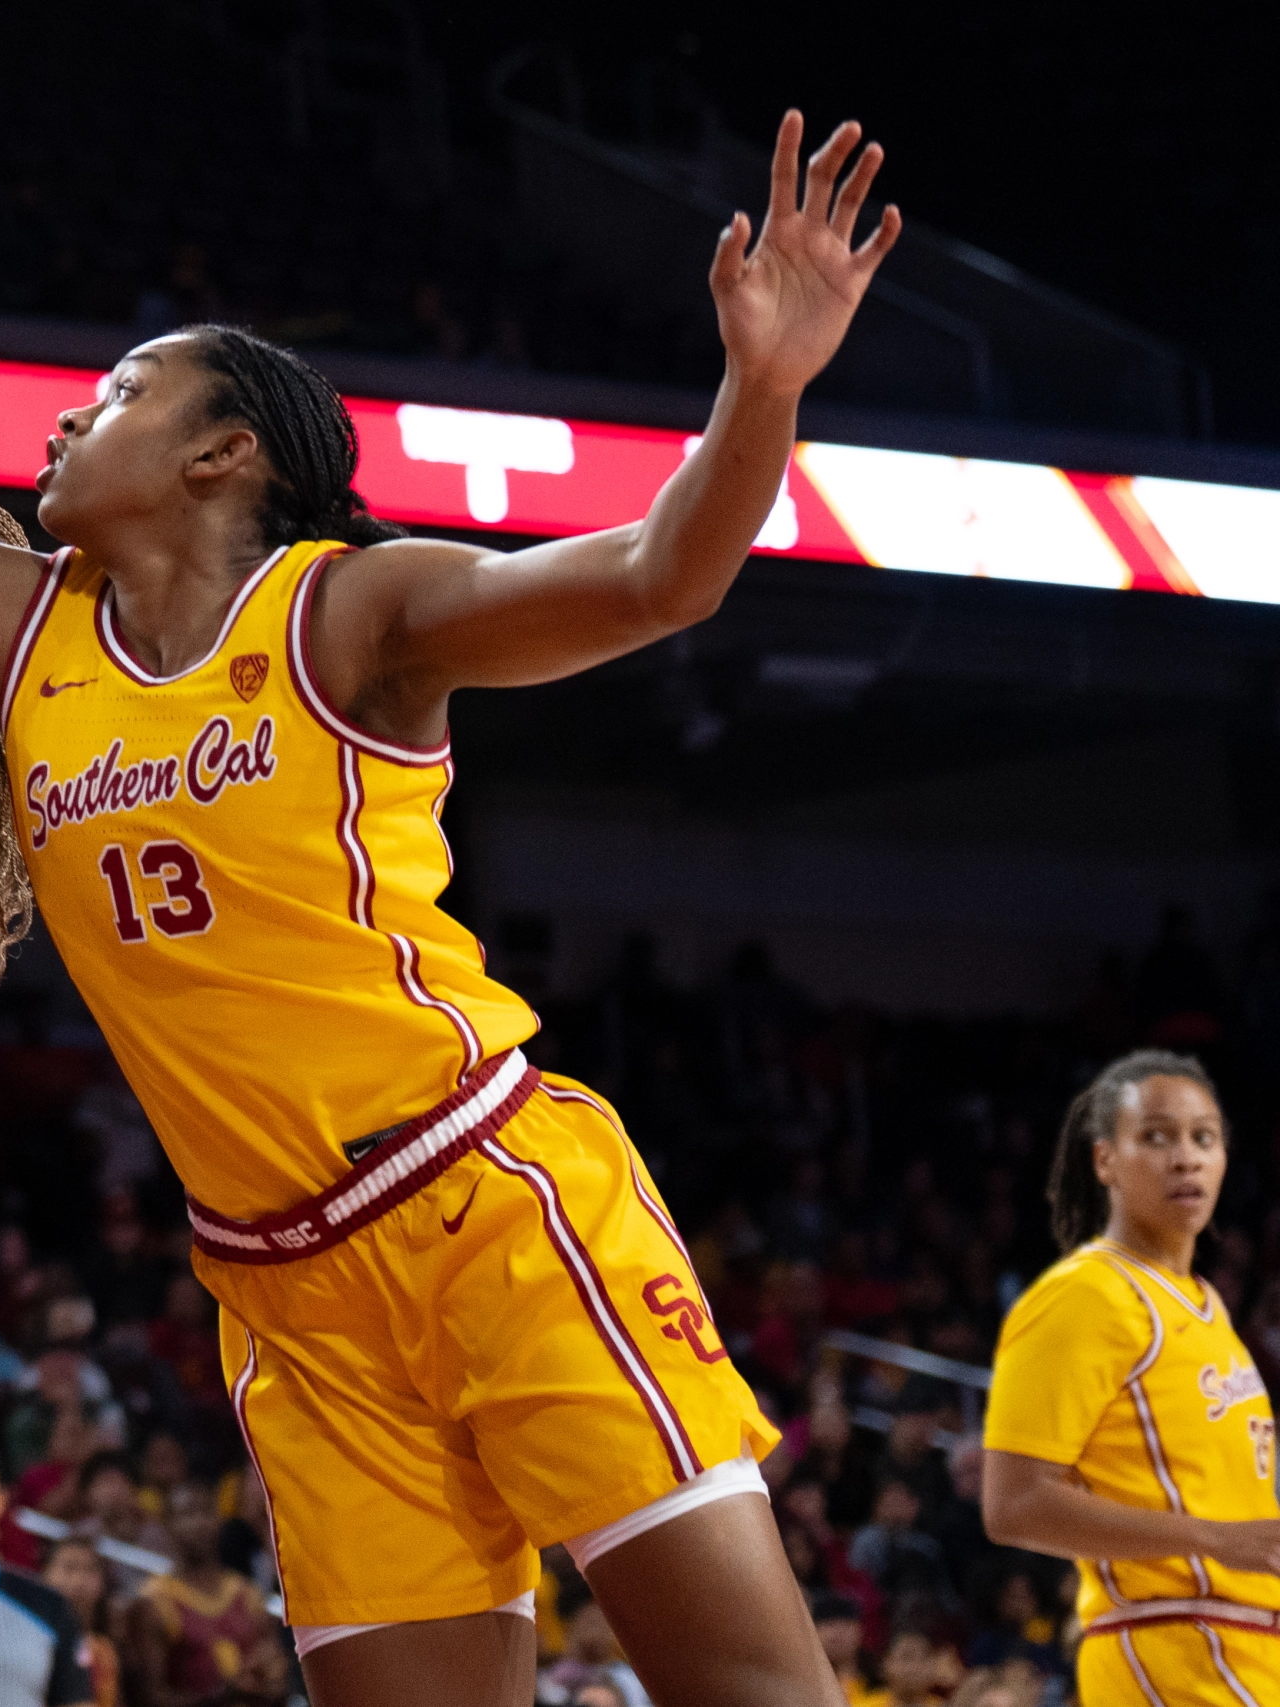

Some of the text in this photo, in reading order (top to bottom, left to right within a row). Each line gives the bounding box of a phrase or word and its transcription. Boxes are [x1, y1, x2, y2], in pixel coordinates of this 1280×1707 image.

[25, 714, 278, 852] Southern Cal
[98, 839, 216, 944] 13
[270, 1220, 321, 1249] USC
